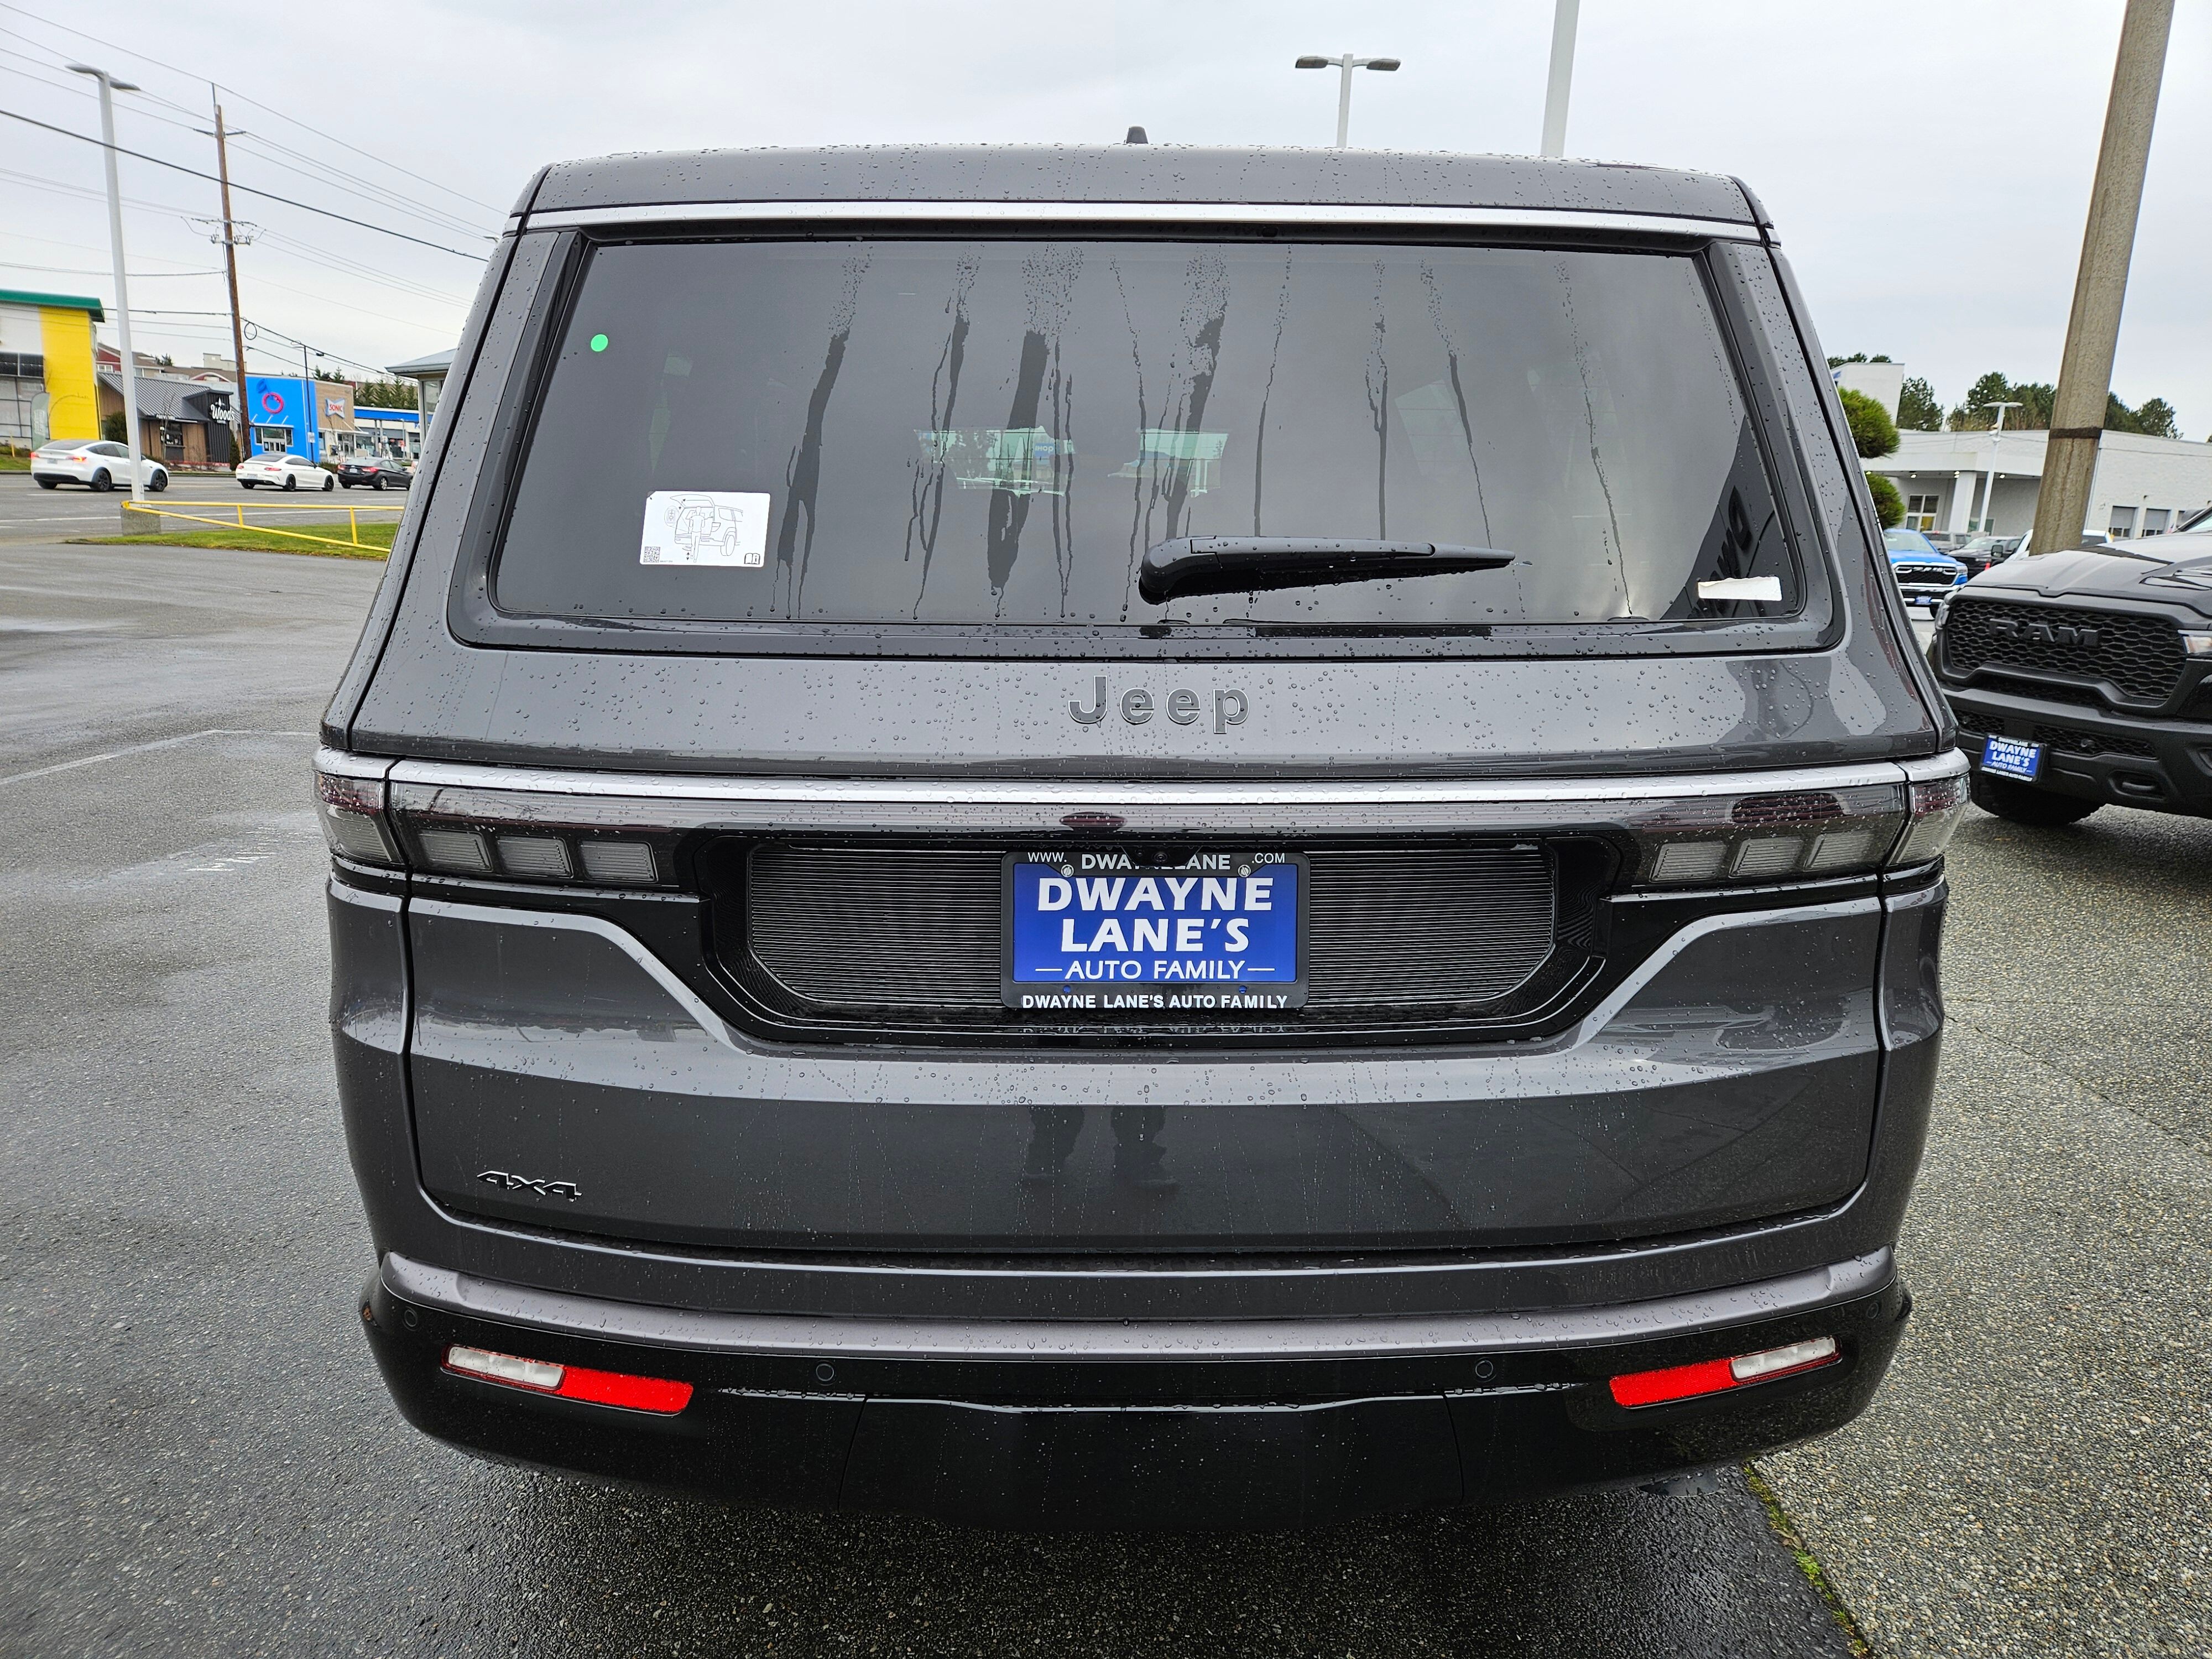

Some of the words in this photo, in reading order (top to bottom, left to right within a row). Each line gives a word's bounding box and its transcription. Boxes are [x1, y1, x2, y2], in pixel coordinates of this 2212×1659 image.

[211, 404, 235, 420] Woods
[1990, 618, 2099, 647] RAM
[1068, 675, 1250, 734] Jeep
[1989, 740, 2037, 758] DWAYNE
[1991, 751, 2030, 767] LANE'S
[1037, 877, 1274, 911] DWAYNE
[1061, 918, 1249, 953] LANE'S
[1065, 960, 1142, 979] AUTO
[1154, 960, 1246, 979] FAMILY
[1022, 995, 1096, 1009] DWAYNE
[1103, 994, 1164, 1009] LANE'S
[1168, 995, 1215, 1009] AUTO
[1220, 995, 1288, 1009] FAMILY
